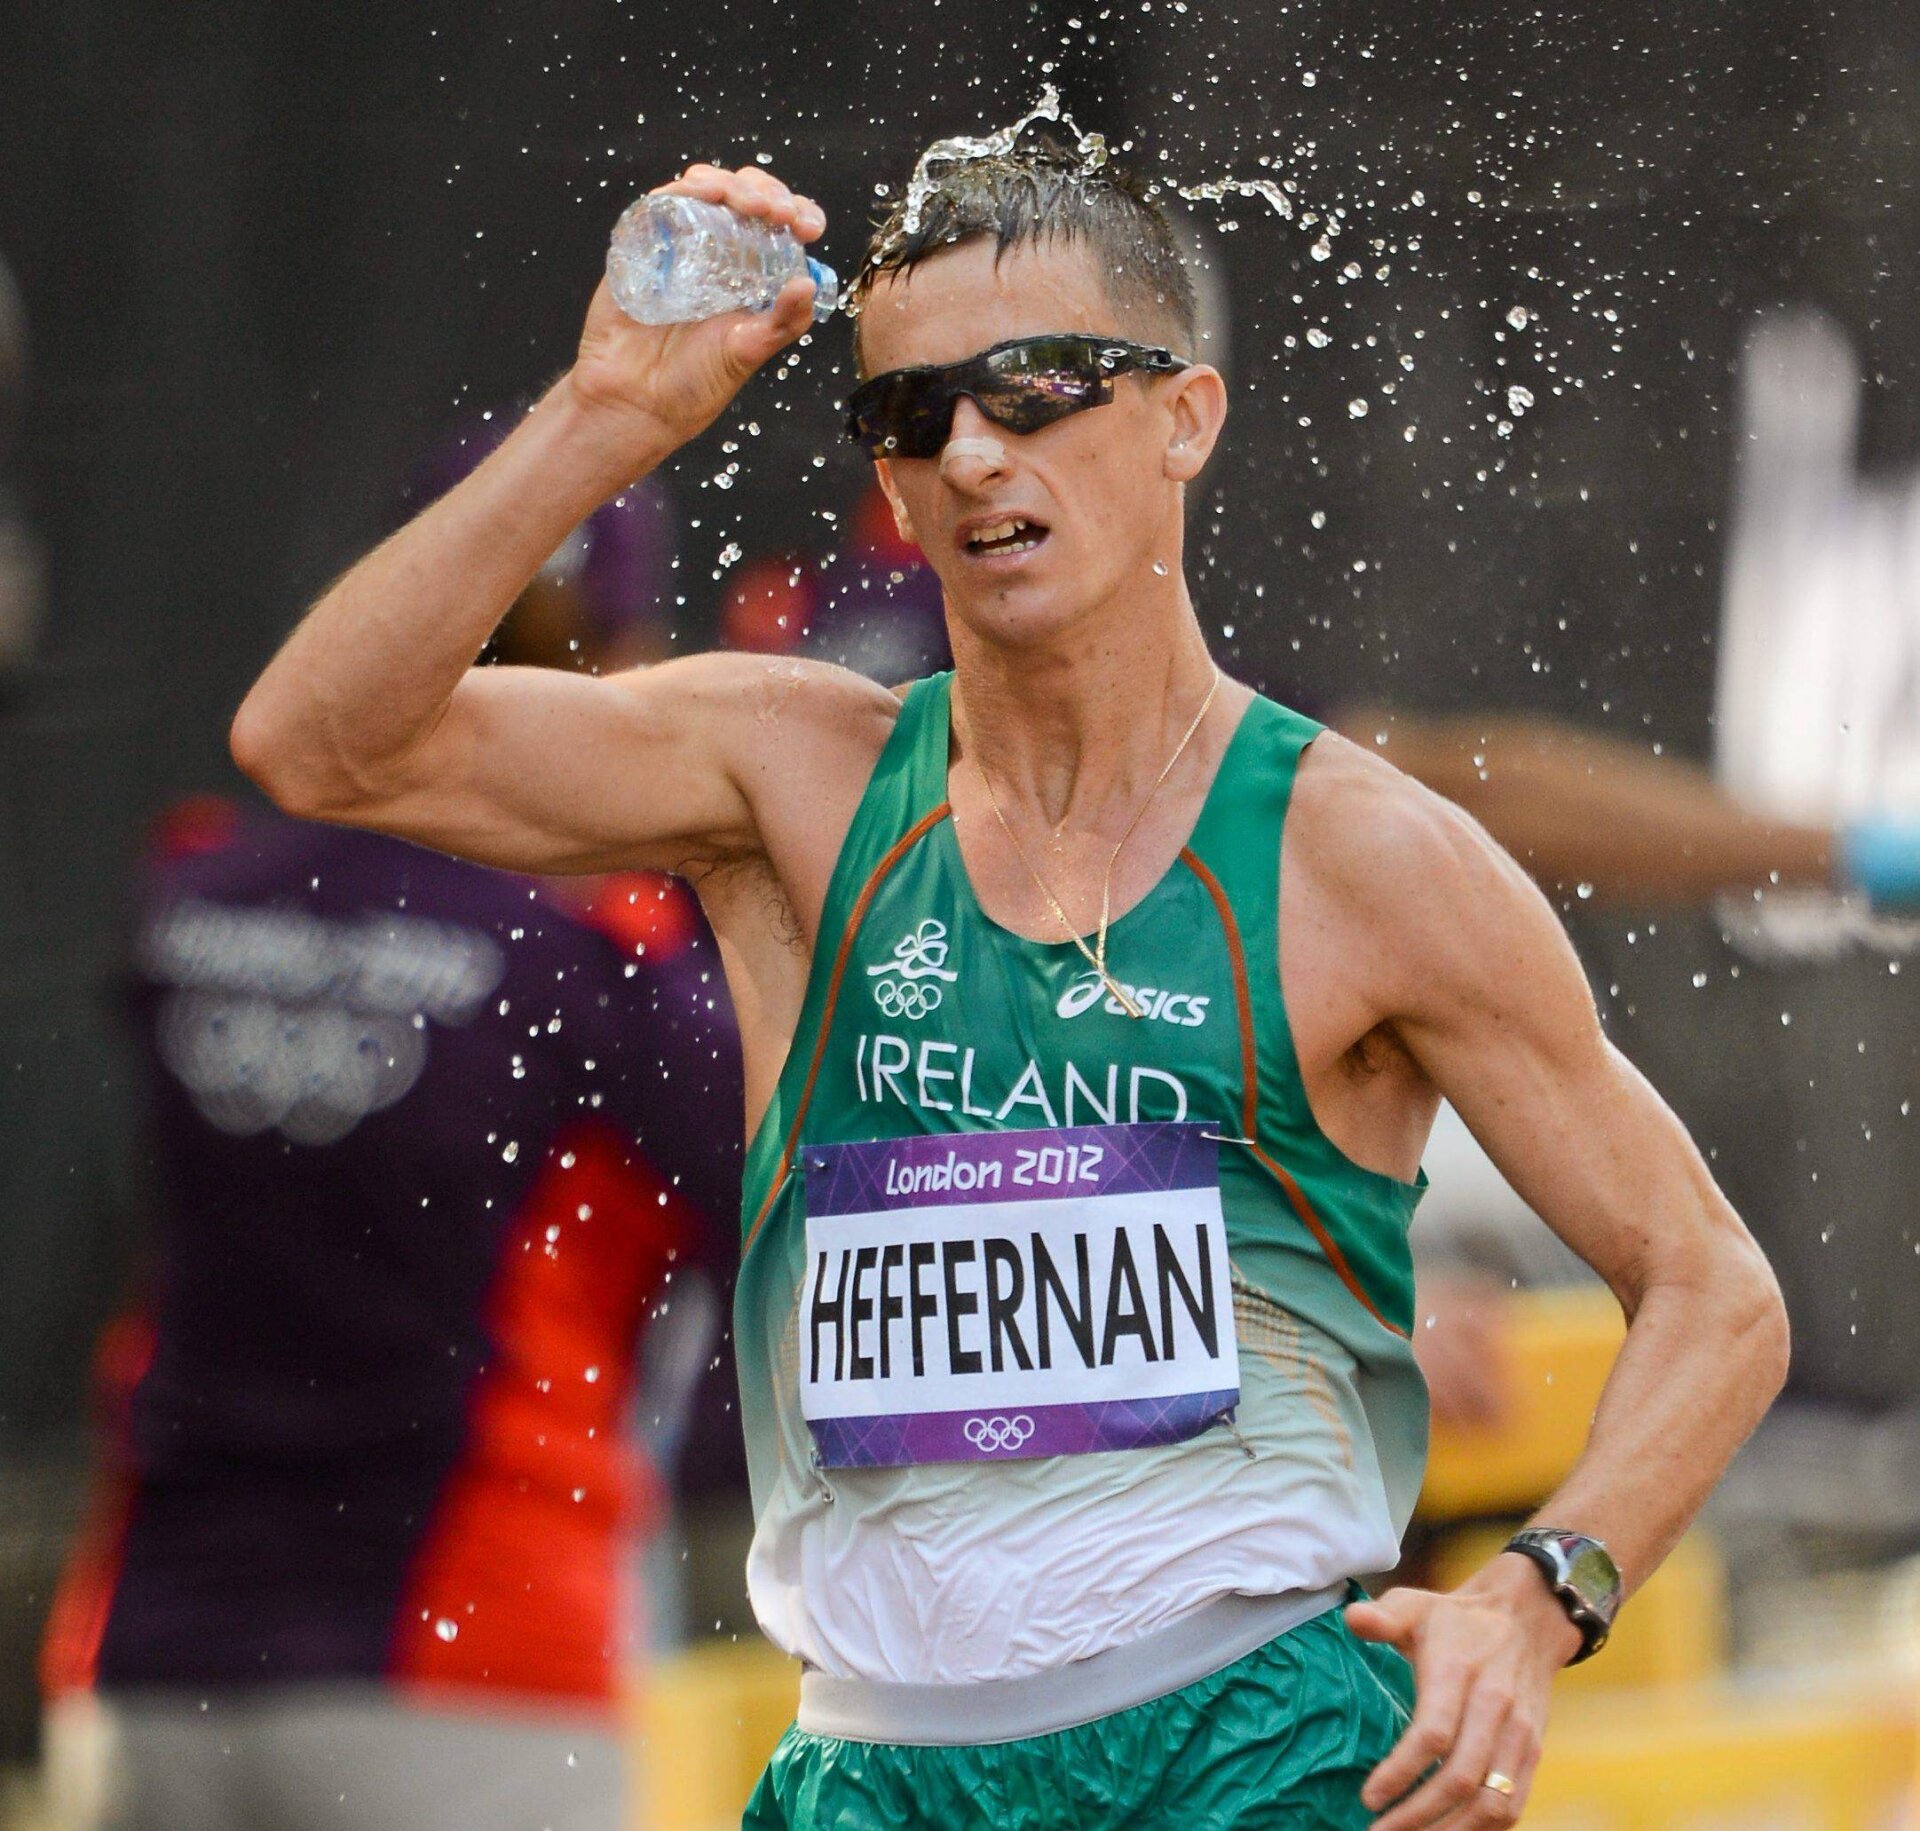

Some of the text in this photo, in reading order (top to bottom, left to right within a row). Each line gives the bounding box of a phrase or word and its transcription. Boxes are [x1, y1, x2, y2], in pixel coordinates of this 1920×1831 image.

[856, 1034, 1188, 1127] IRELAND
[886, 1145, 1104, 1196] London 2012
[810, 1223, 1220, 1383] HEFFERNAN
